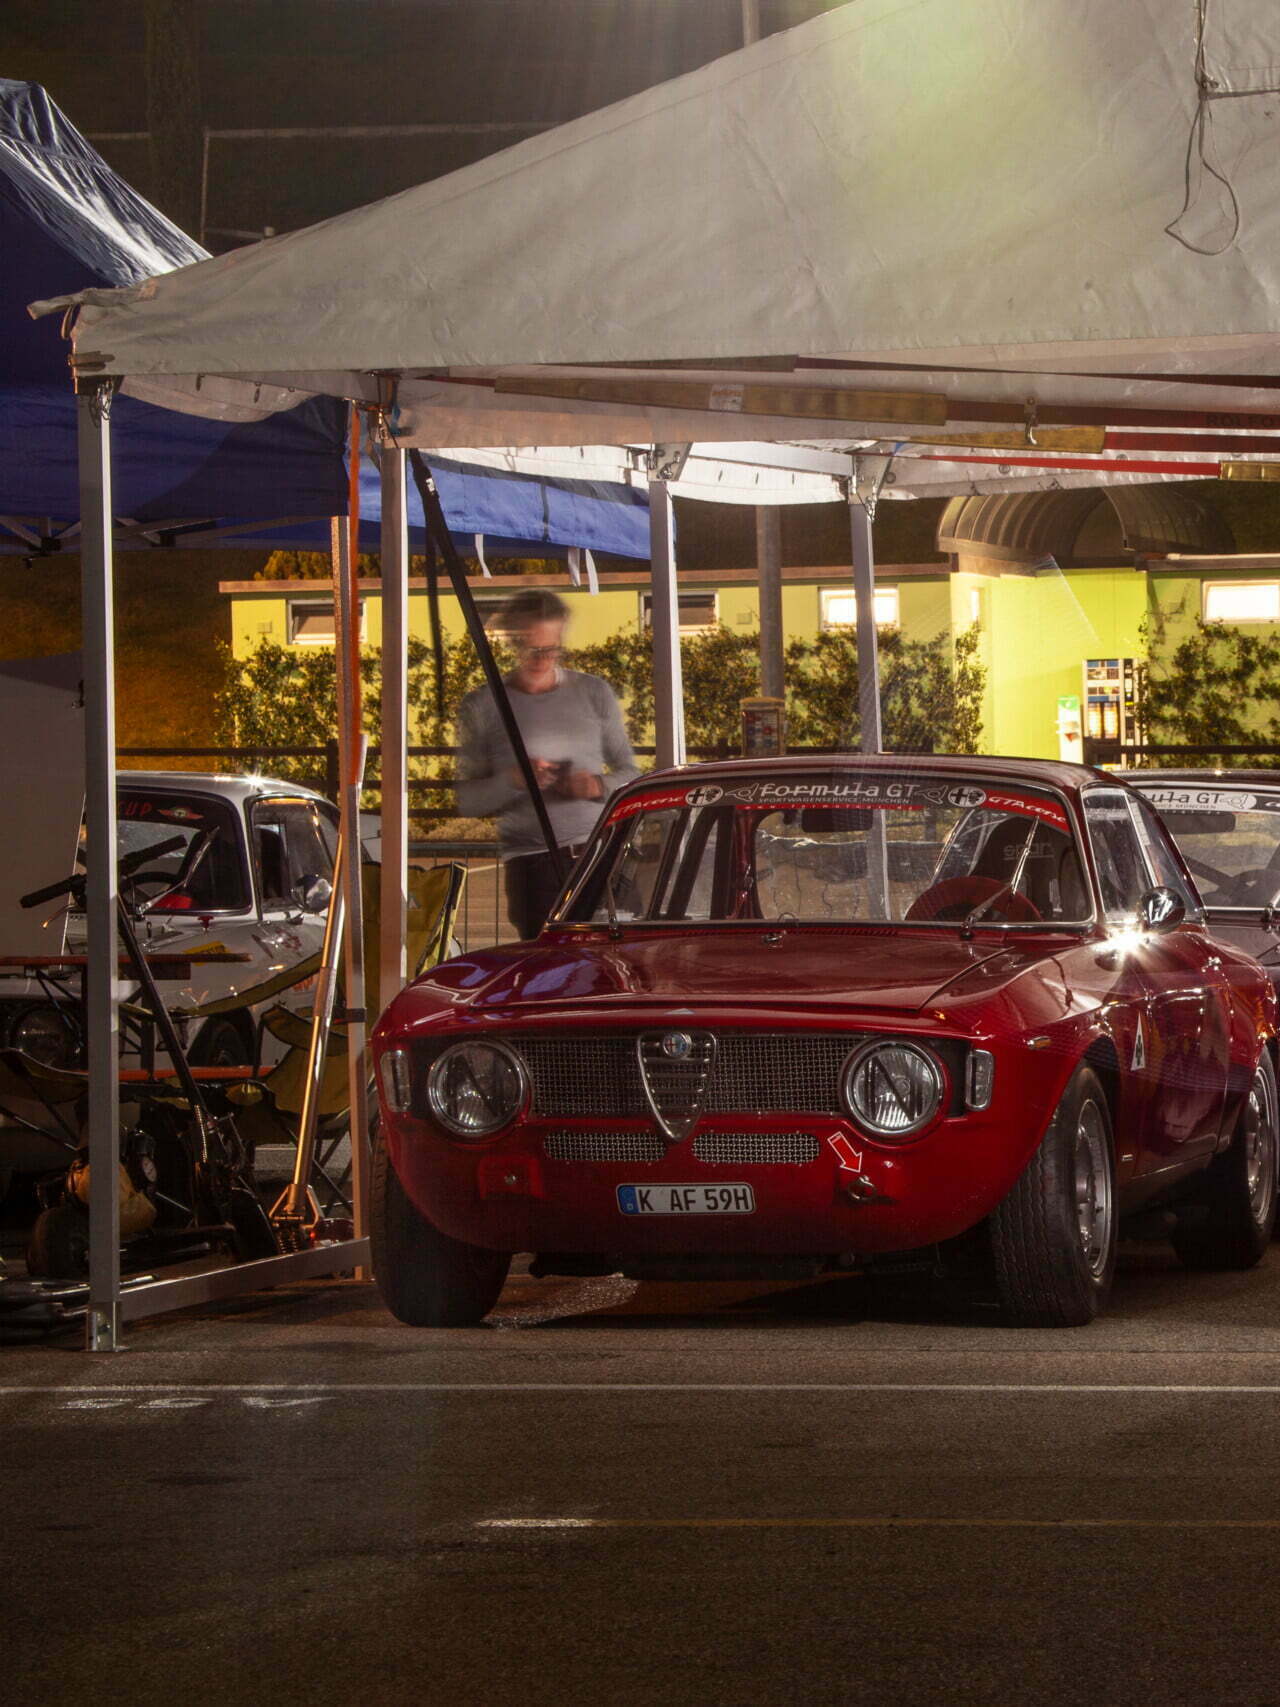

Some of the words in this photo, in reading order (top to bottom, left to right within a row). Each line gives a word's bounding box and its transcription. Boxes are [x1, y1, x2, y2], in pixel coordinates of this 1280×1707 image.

[759, 782, 880, 797] formula
[886, 784, 920, 797] GT
[1196, 792, 1225, 804] GT
[638, 1189, 654, 1212] K
[670, 1189, 697, 1212] AF
[704, 1188, 750, 1211] 59H
